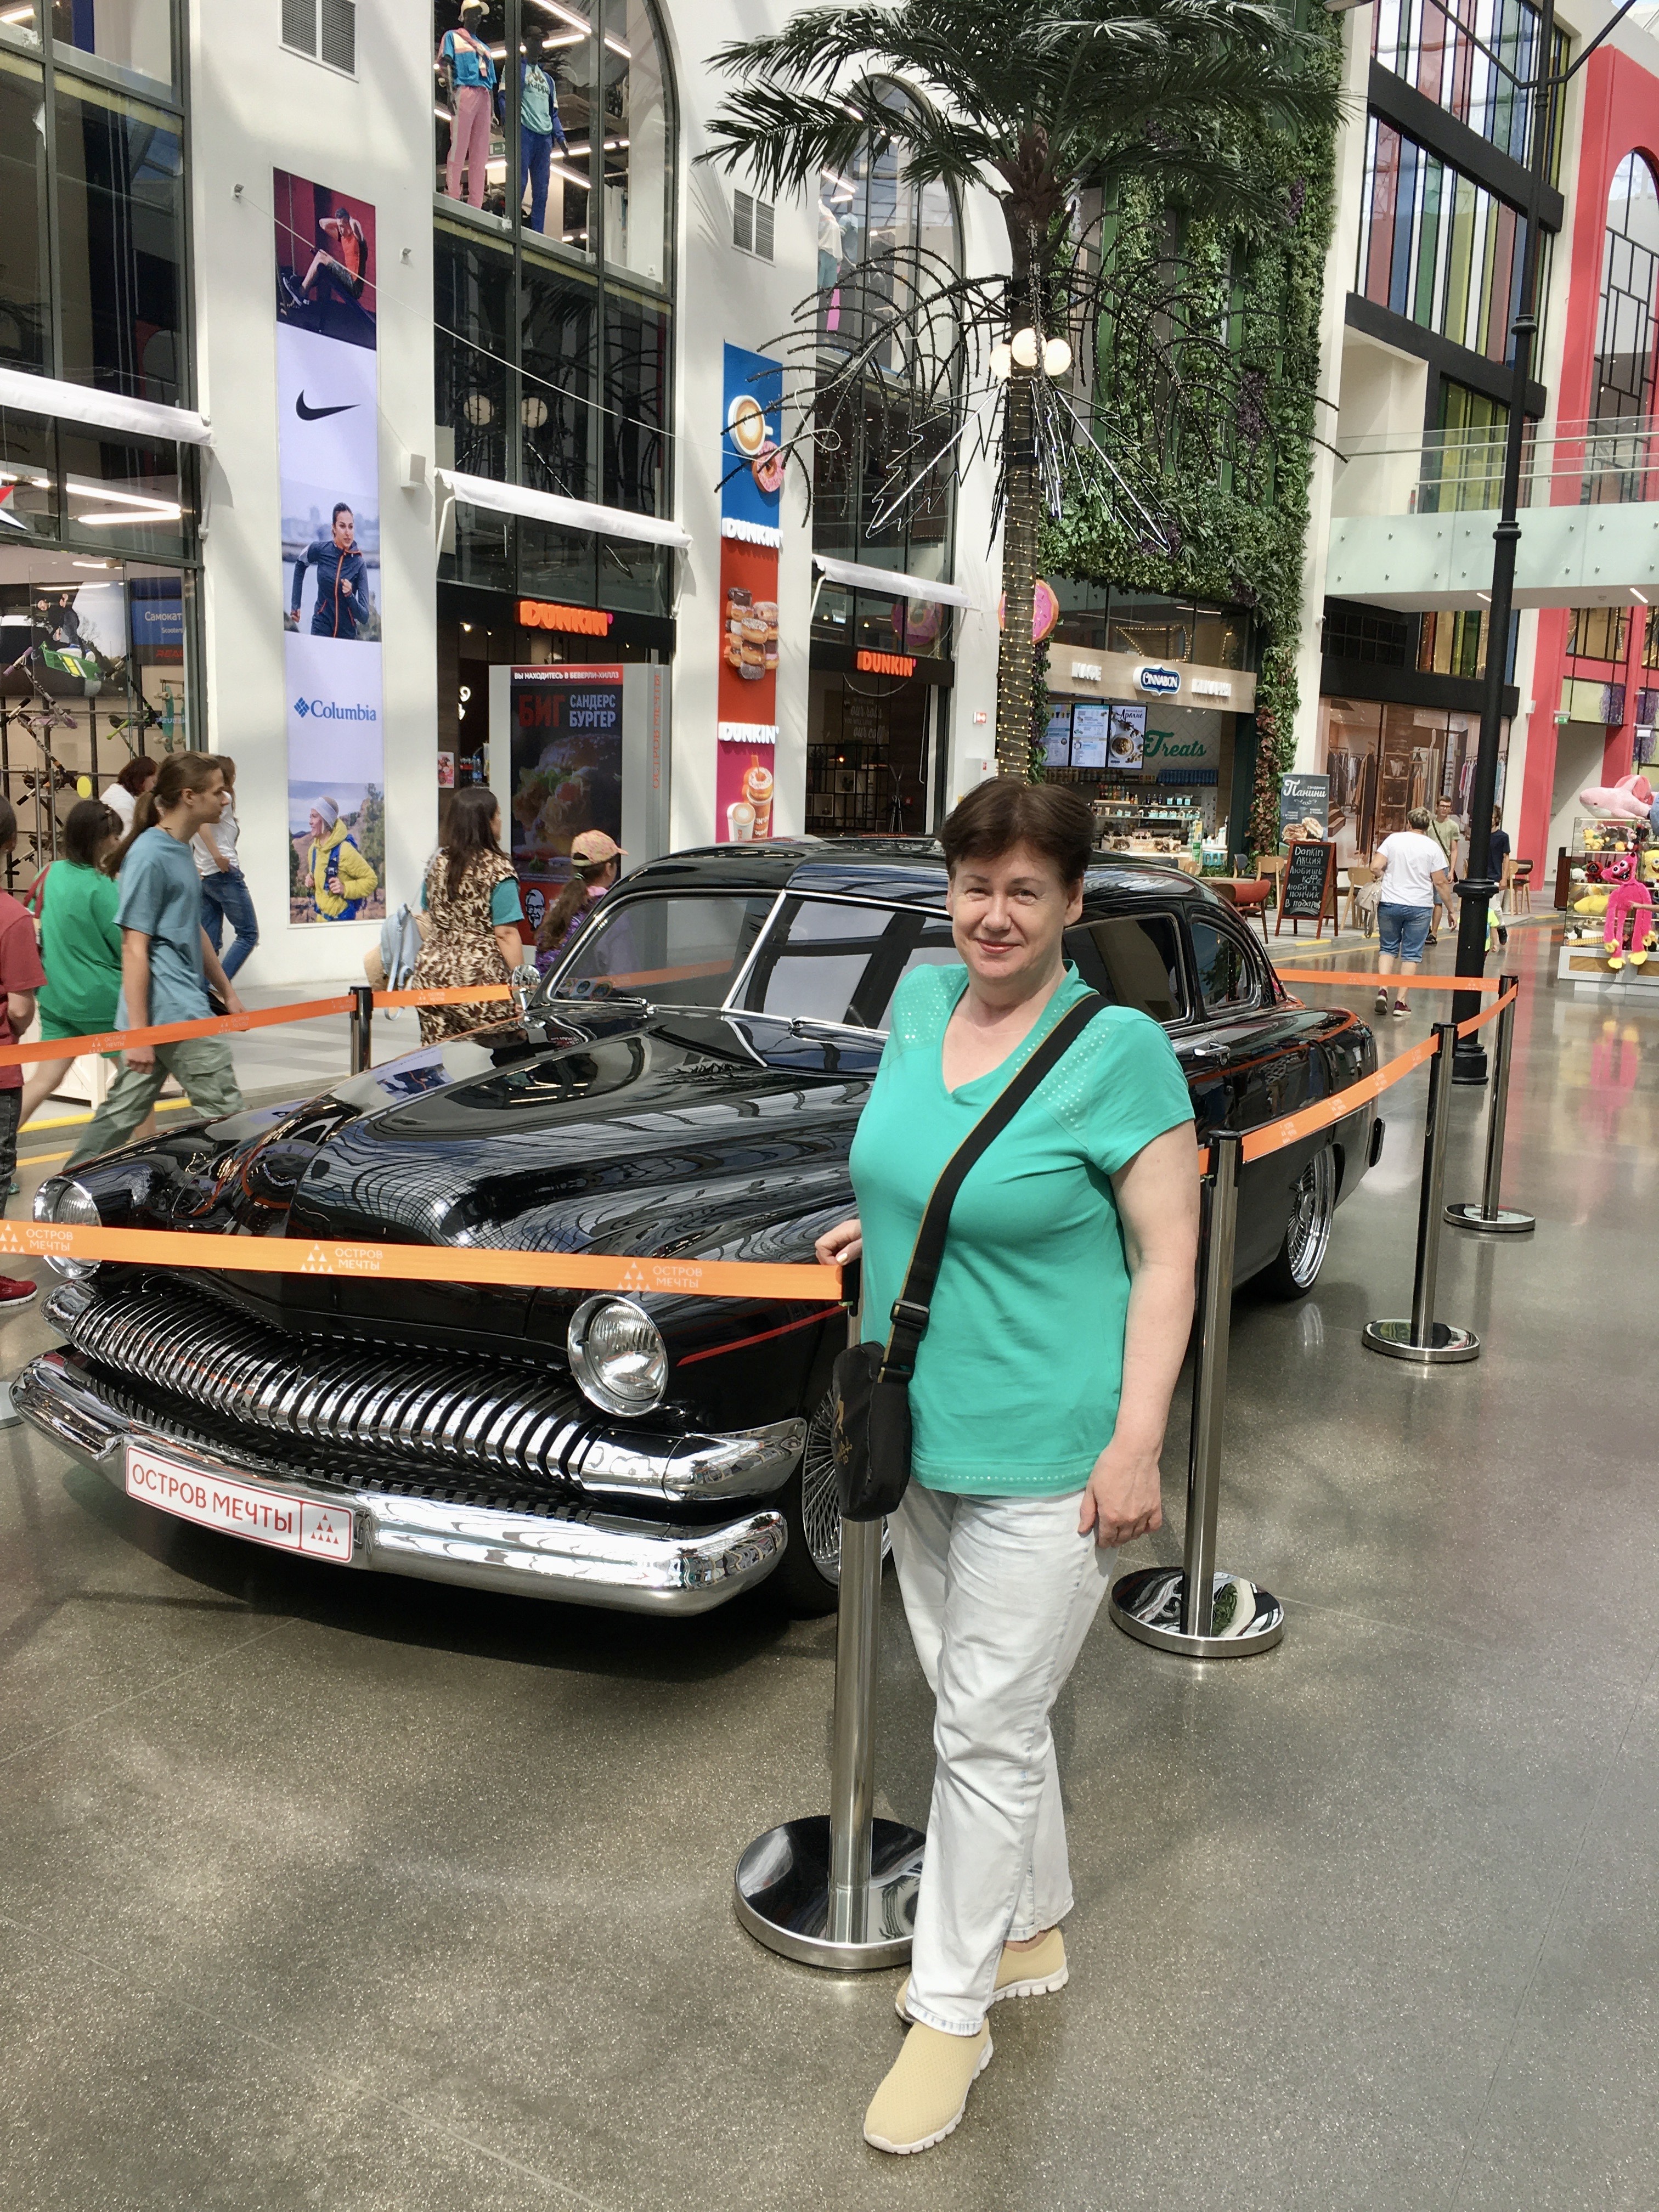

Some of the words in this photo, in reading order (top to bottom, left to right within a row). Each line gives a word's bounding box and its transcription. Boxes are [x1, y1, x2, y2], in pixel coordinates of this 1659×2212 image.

[722, 518, 783, 548] DUNKIN'
[520, 601, 613, 637] DUNKIN'
[857, 651, 916, 677] DUNKIN'
[525, 672, 563, 680] НАХОДИТЕСЬ
[311, 700, 377, 721] Columbia
[518, 694, 566, 727] БИГ
[570, 694, 616, 710] САНДЕРС
[569, 710, 616, 728] БУРГЕР
[718, 721, 779, 744] DUNKIN'
[1143, 730, 1206, 758] Treats
[1283, 780, 1327, 798] Панини
[1296, 856, 1321, 865] АКЦИЯ
[26, 1228, 74, 1242] ОСТРОВ
[30, 1240, 71, 1252] МЕЧТЫ
[335, 1248, 384, 1260] ОСТРОВ
[338, 1258, 380, 1271] МЕЧТЫ
[653, 1266, 703, 1277] ОСТРОВ
[657, 1277, 699, 1288] МЕЧТЫ
[132, 1464, 207, 1509] ОСТРОВ
[212, 1492, 293, 1533] МЕЧТЫ
